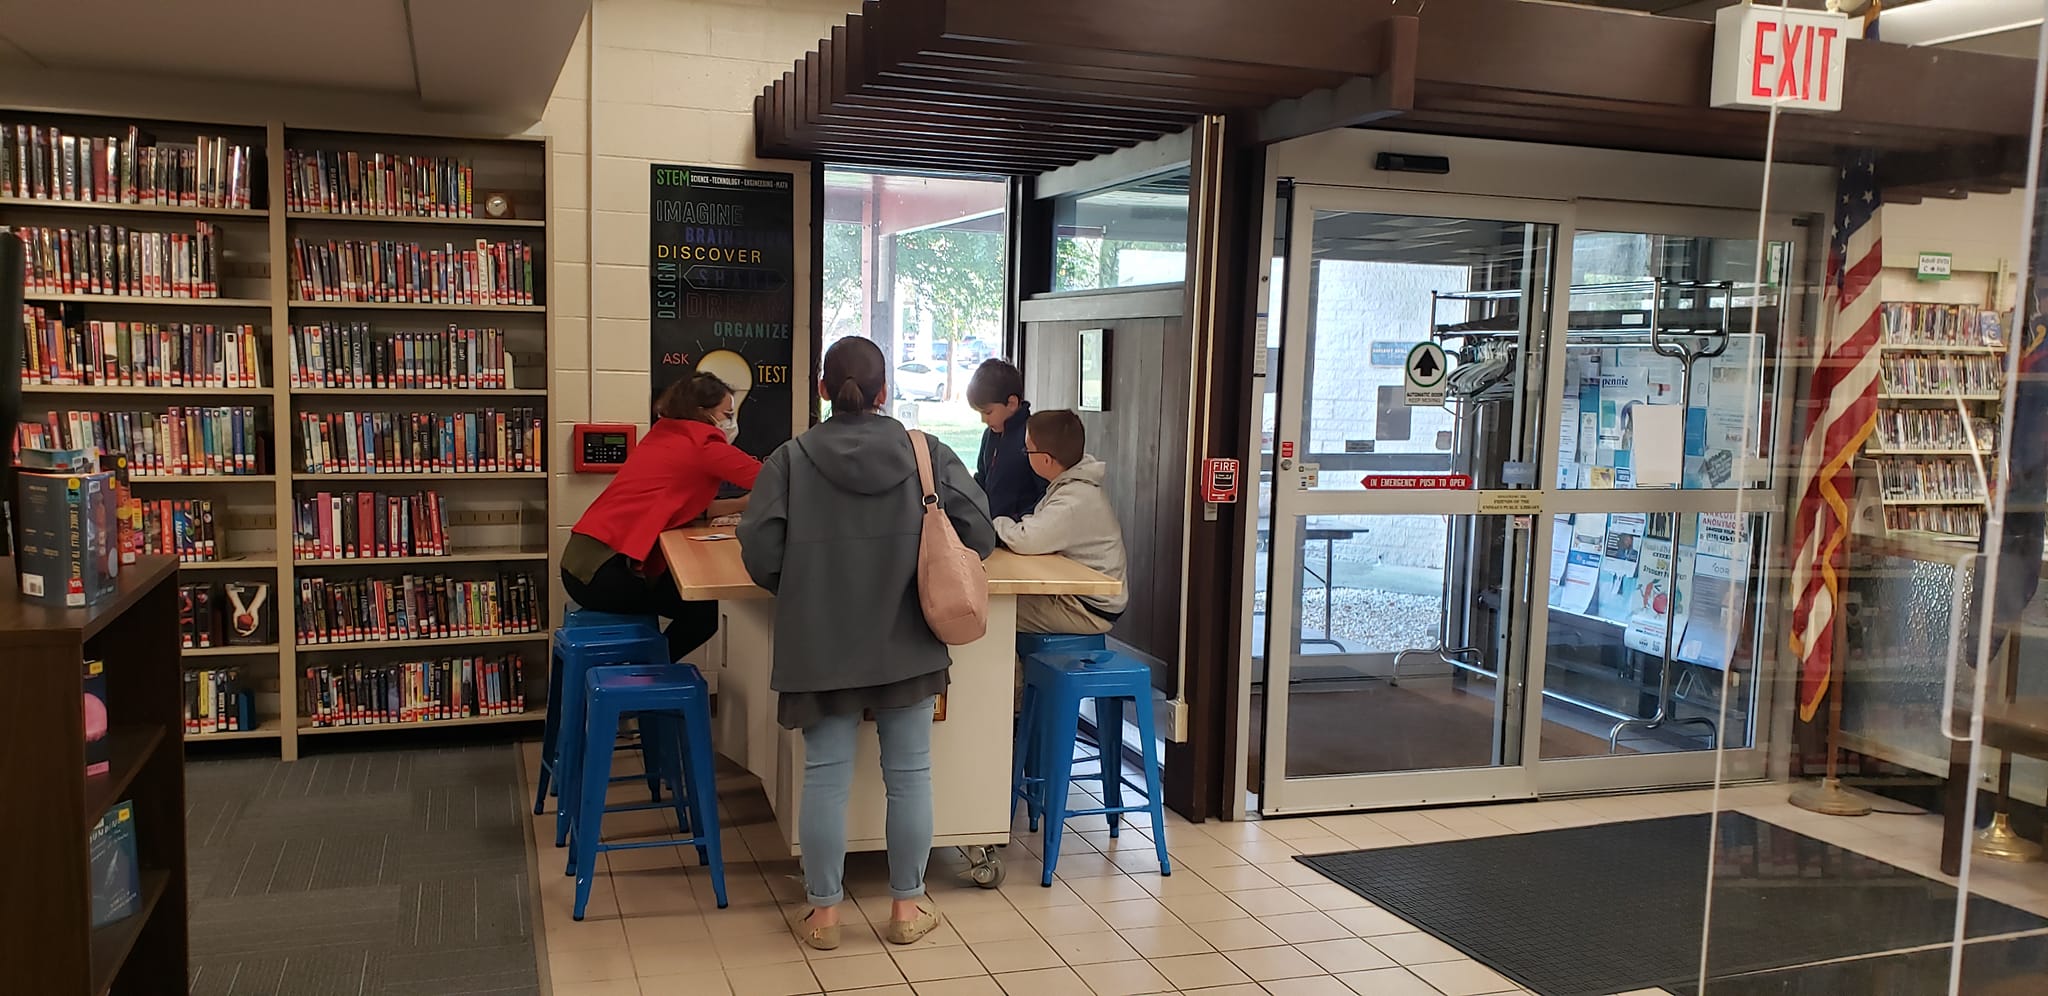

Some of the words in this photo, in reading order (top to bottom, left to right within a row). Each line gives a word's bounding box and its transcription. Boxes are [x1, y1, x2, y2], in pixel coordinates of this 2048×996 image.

[1751, 21, 1838, 102] EXIT
[656, 169, 690, 186] STEM
[690, 174, 710, 184] SCIENCE
[712, 176, 741, 185] TECHNOLOGY
[744, 178, 773, 188] ENGINEERING
[775, 180, 788, 189] MATH
[656, 200, 744, 226] IMAGINE
[657, 244, 761, 264] DISCOVER
[657, 262, 677, 319] DESIGN
[713, 321, 789, 340] ORGANIZE
[662, 352, 689, 365] ASK
[757, 365, 788, 384] TEST
[1602, 375, 1629, 389] pennie
[1213, 461, 1236, 471] FIRE
[1370, 478, 1378, 487] IN
[1380, 478, 1417, 487] EMERGENCY
[1419, 478, 1436, 487] PUSH
[1438, 478, 1447, 487] TO
[1449, 478, 1466, 487] OPEN
[1702, 518, 1745, 531] ANONYMOS
[1703, 512, 1744, 522] NARCOTIS
